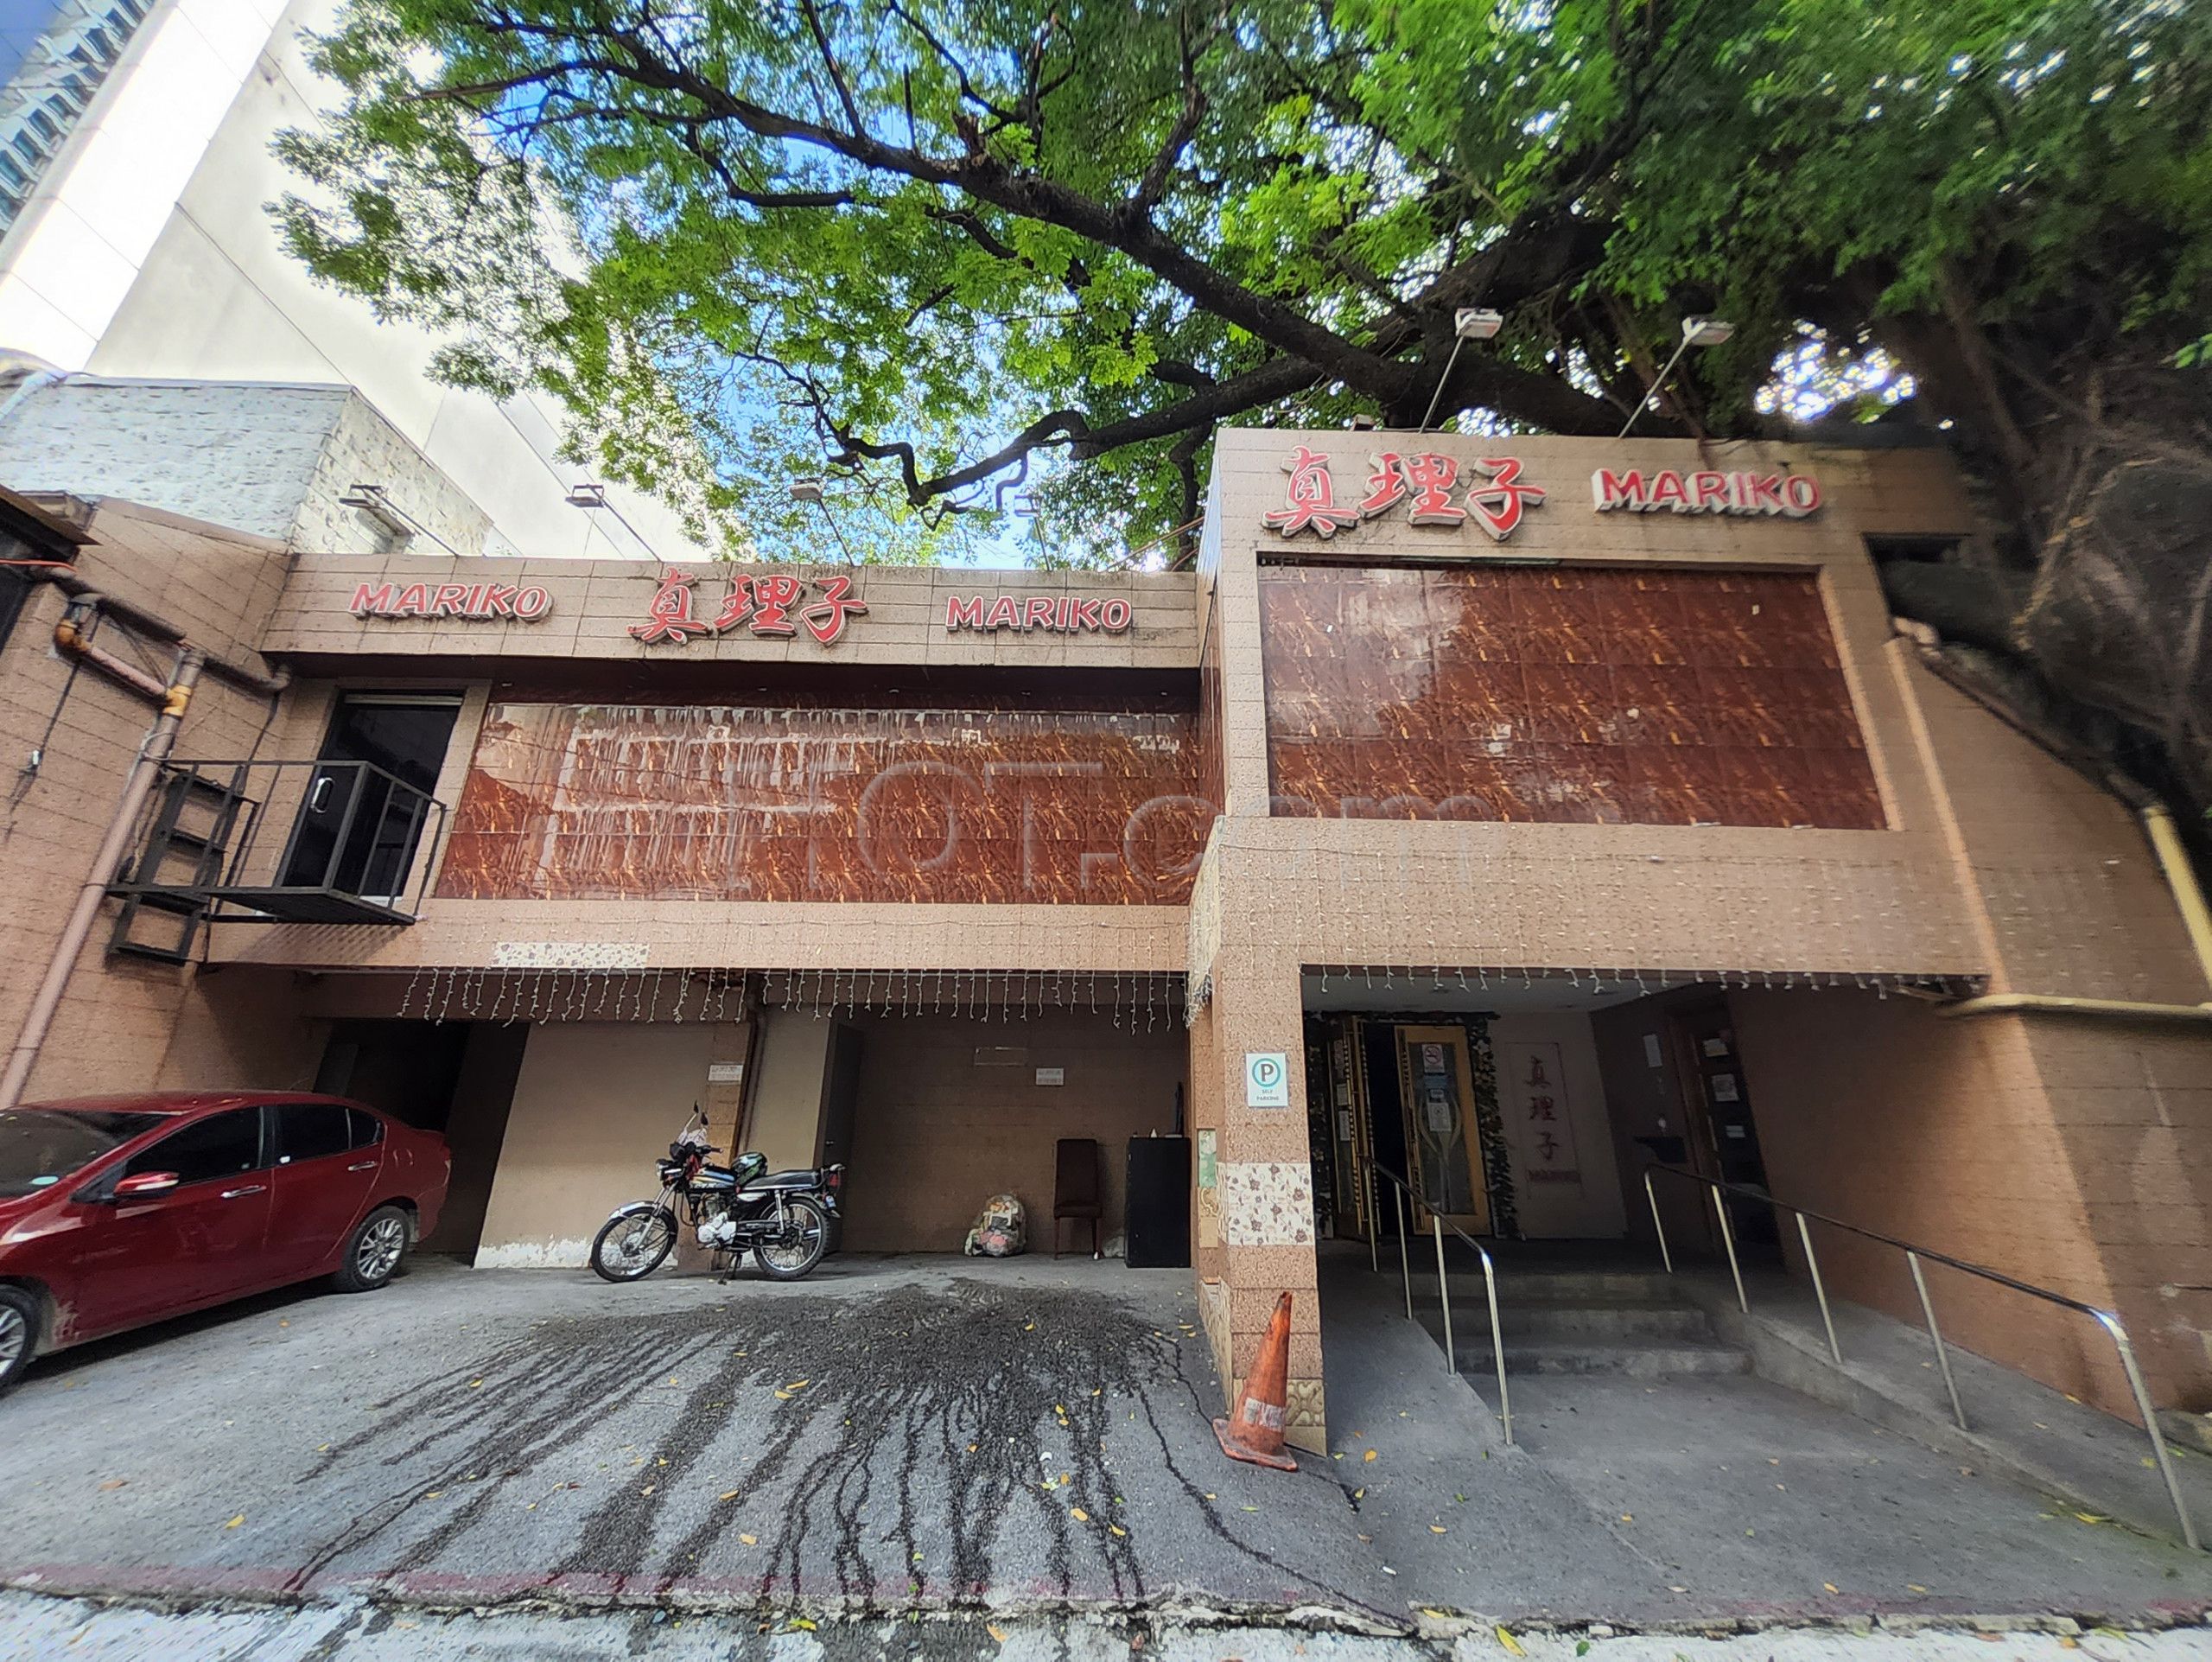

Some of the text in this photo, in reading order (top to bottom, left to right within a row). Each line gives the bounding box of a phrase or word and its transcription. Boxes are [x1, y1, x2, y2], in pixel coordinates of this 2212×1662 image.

[1262, 445, 1547, 539] 真理子
[1592, 468, 1823, 519] MARIKO
[349, 582, 553, 621] MARIKO
[627, 567, 868, 646] 真理子
[945, 595, 1133, 634] MARIKO
[1261, 1063, 1274, 1082] P
